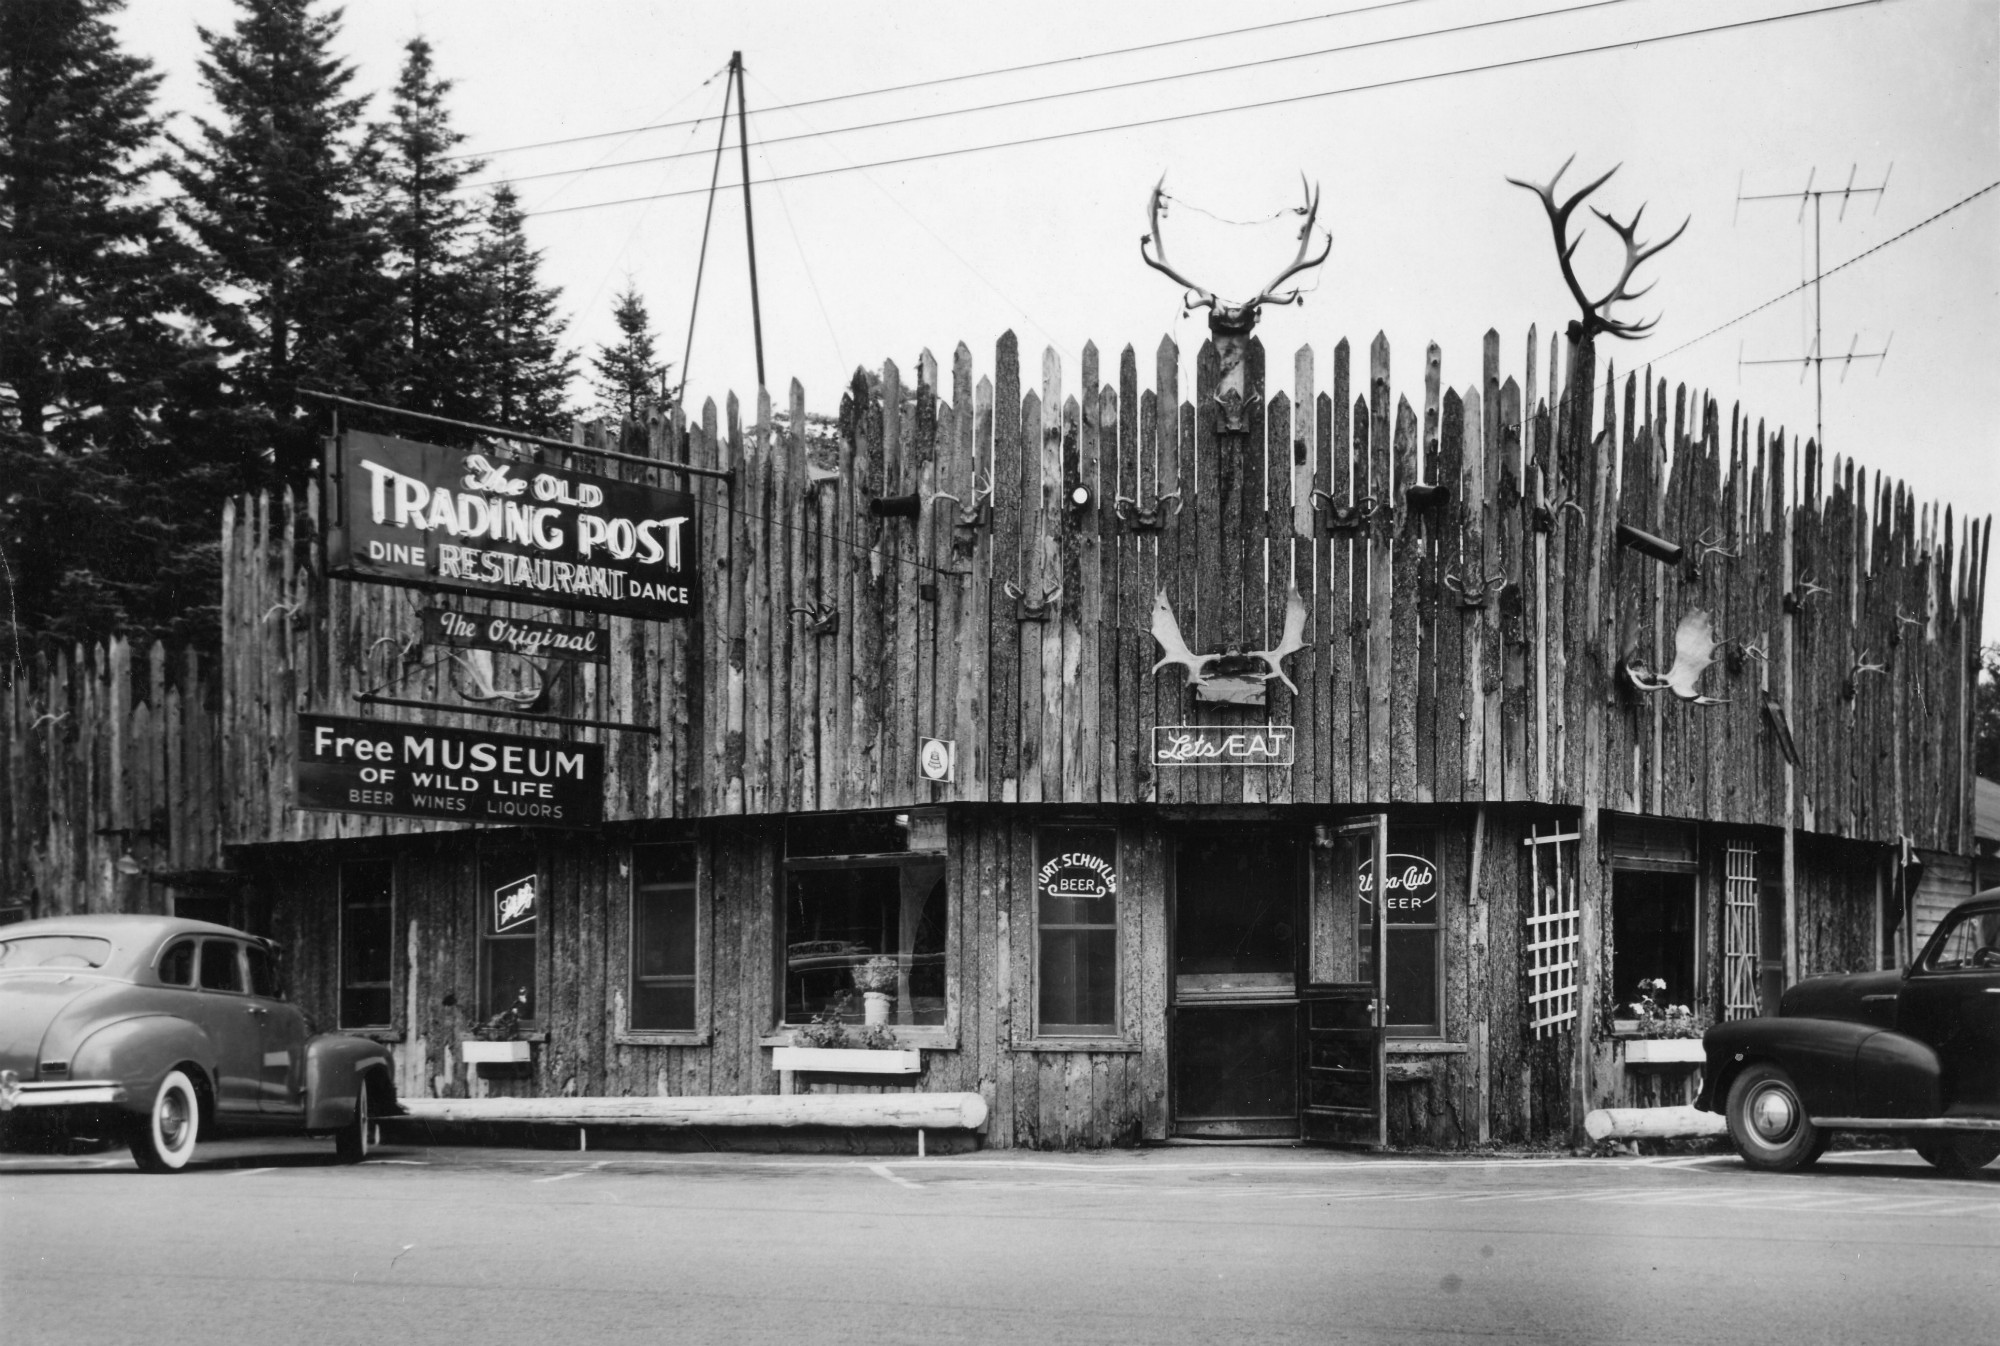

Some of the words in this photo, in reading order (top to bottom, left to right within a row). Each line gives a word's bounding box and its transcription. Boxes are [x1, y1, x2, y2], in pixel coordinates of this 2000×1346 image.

[459, 454, 528, 496] The
[531, 473, 604, 508] OLD
[359, 459, 564, 550] TRADING
[577, 516, 689, 572] POST
[369, 540, 426, 567] DINE
[438, 543, 628, 600] RESTAURANT
[629, 579, 689, 604] DANCE
[440, 612, 476, 638] The
[488, 619, 598, 655] Original
[314, 726, 394, 761] Free
[403, 735, 585, 780] MUSEUM
[1229, 733, 1286, 757] EAT
[359, 767, 396, 784] OF
[411, 772, 479, 792] WILD
[493, 779, 554, 799] LIFE
[349, 789, 394, 806] BEER
[411, 794, 467, 812] WINES
[486, 801, 564, 819] LIQUORS
[1060, 878, 1095, 891] BEER
[1386, 897, 1422, 909] EER
